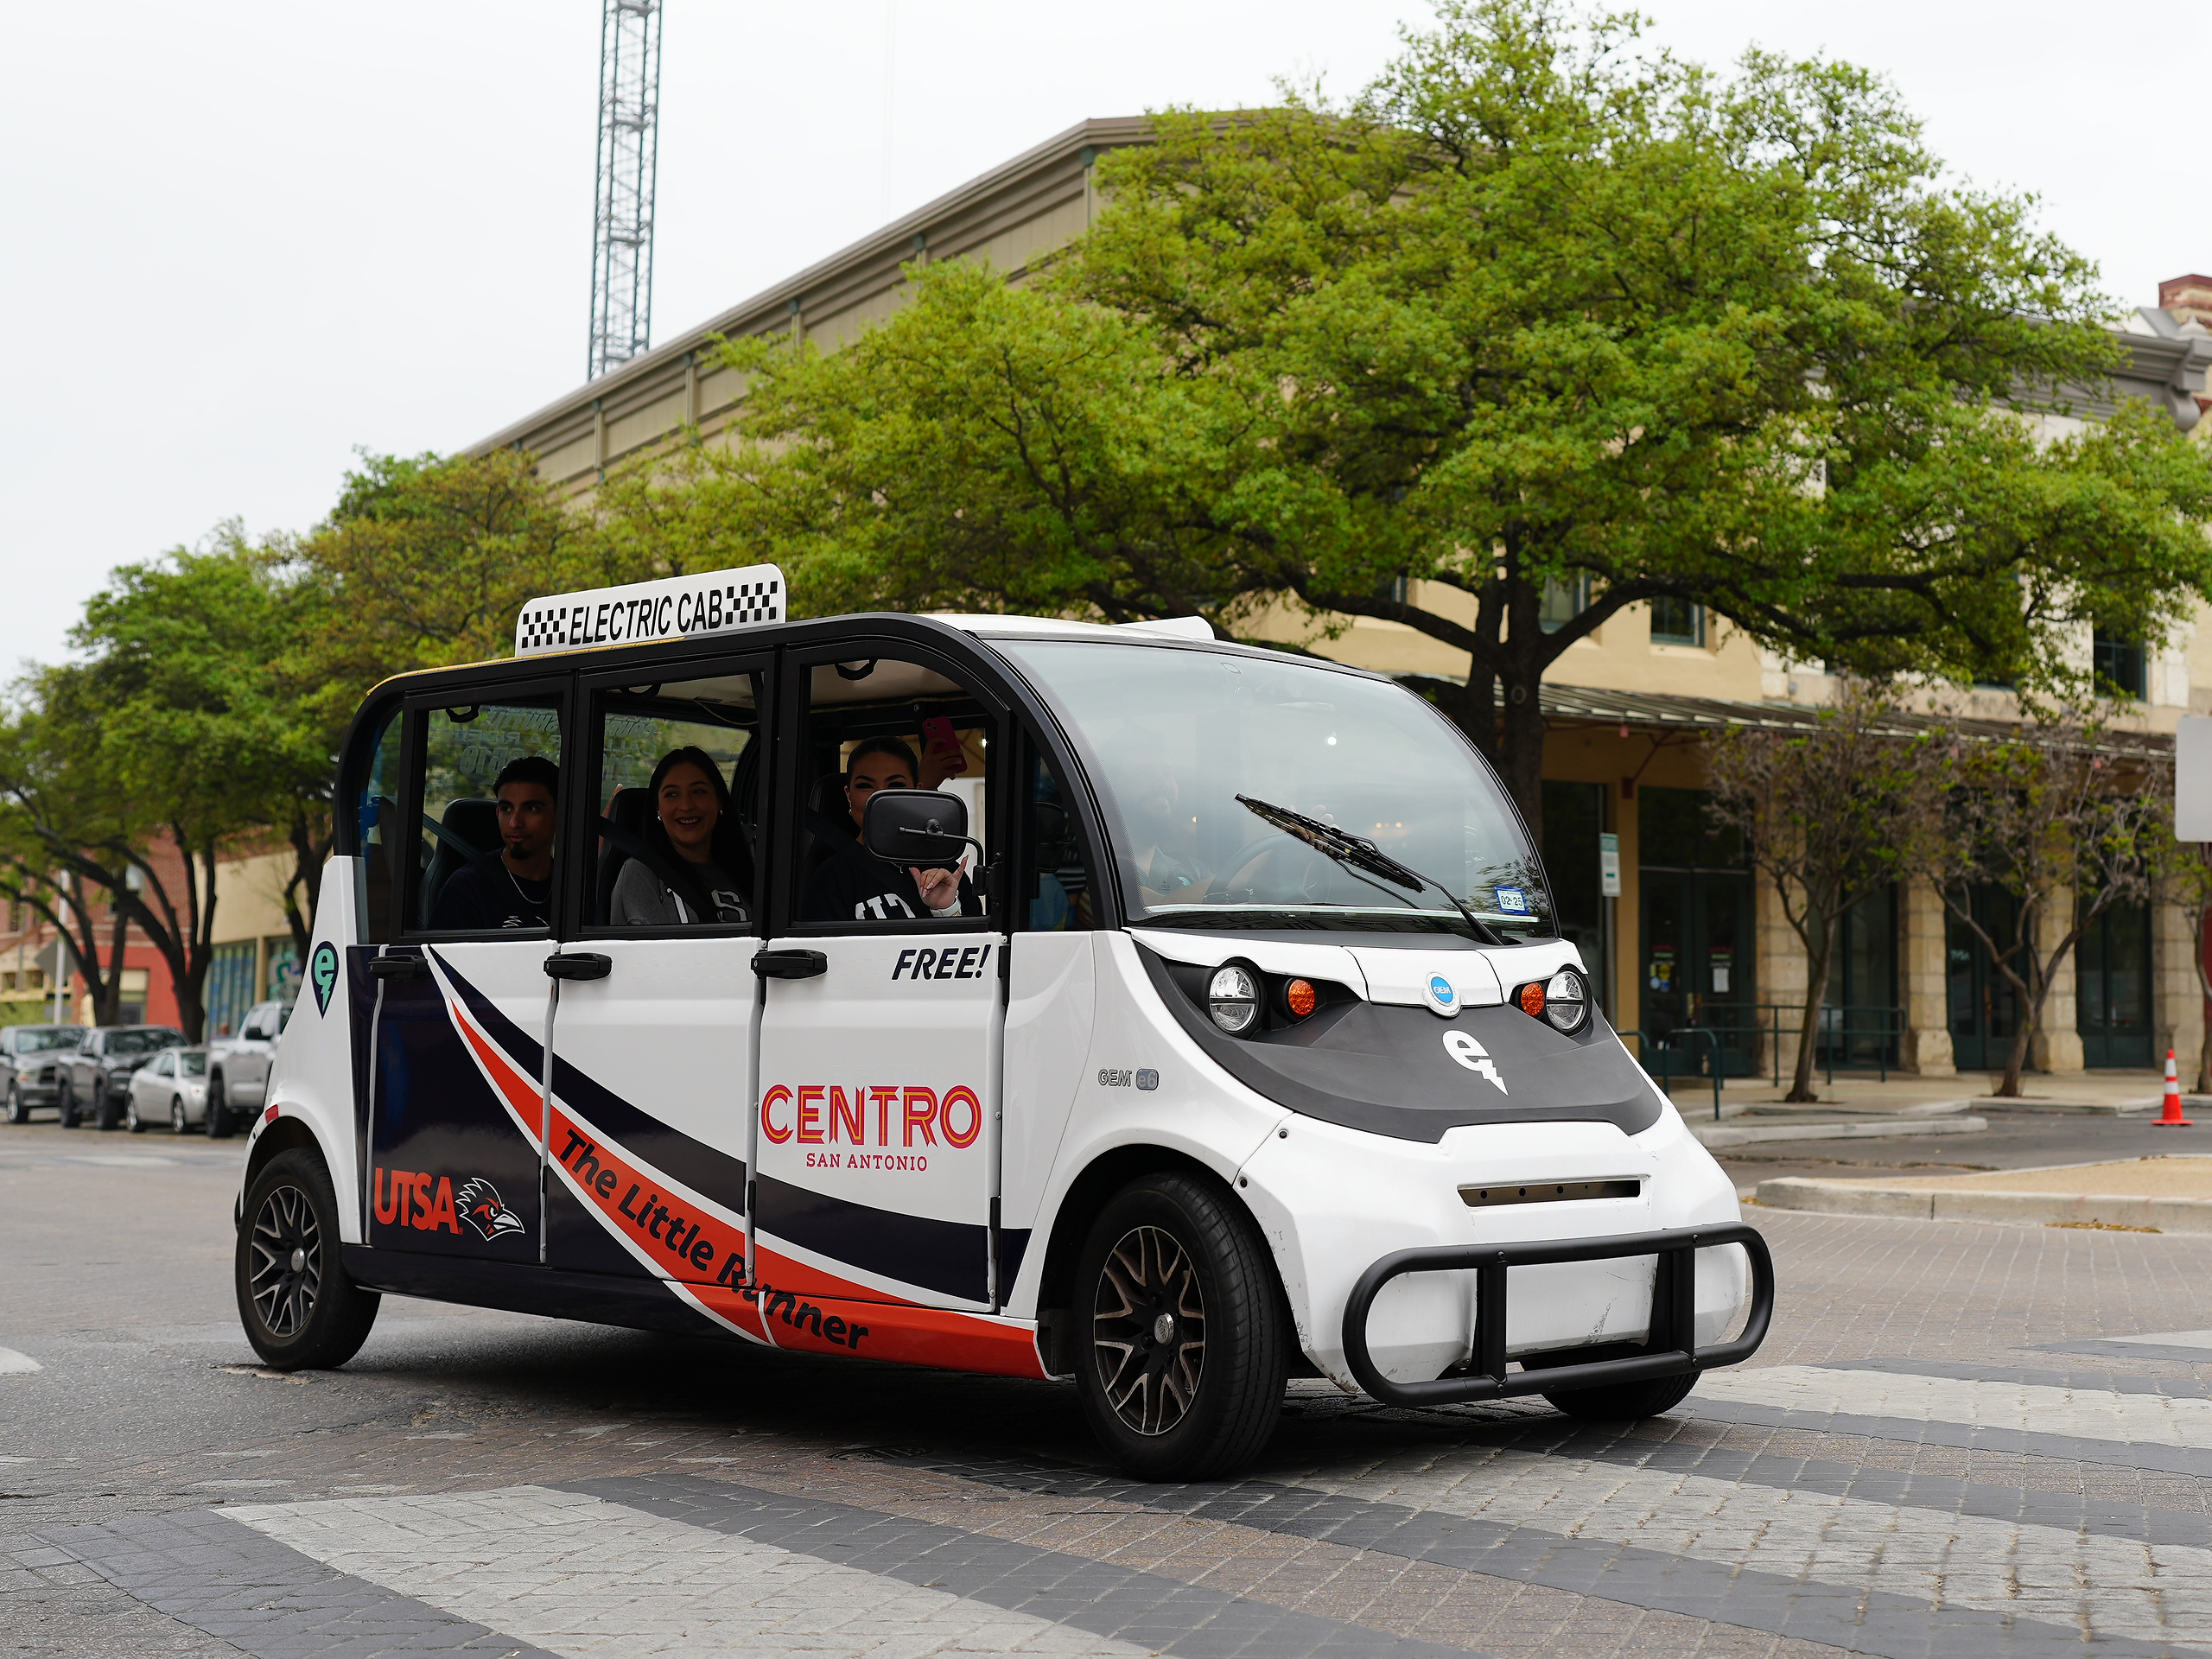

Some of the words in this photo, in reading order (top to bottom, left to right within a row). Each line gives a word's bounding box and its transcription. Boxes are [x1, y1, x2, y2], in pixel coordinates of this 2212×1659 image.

[569, 595, 672, 645] ELECTRIC
[677, 588, 722, 633] CAB
[1501, 895, 1523, 906] 02-25
[892, 944, 991, 981] FREE!
[1098, 1069, 1132, 1087] GEM
[1138, 1071, 1156, 1088] e6
[760, 1084, 982, 1149] CENTRO
[806, 1153, 841, 1168] SAN
[847, 1154, 928, 1172] ANTONIO
[374, 1167, 460, 1235] UTSA
[559, 1128, 617, 1199] The
[617, 1183, 715, 1272] Little
[716, 1252, 869, 1350] Runner
